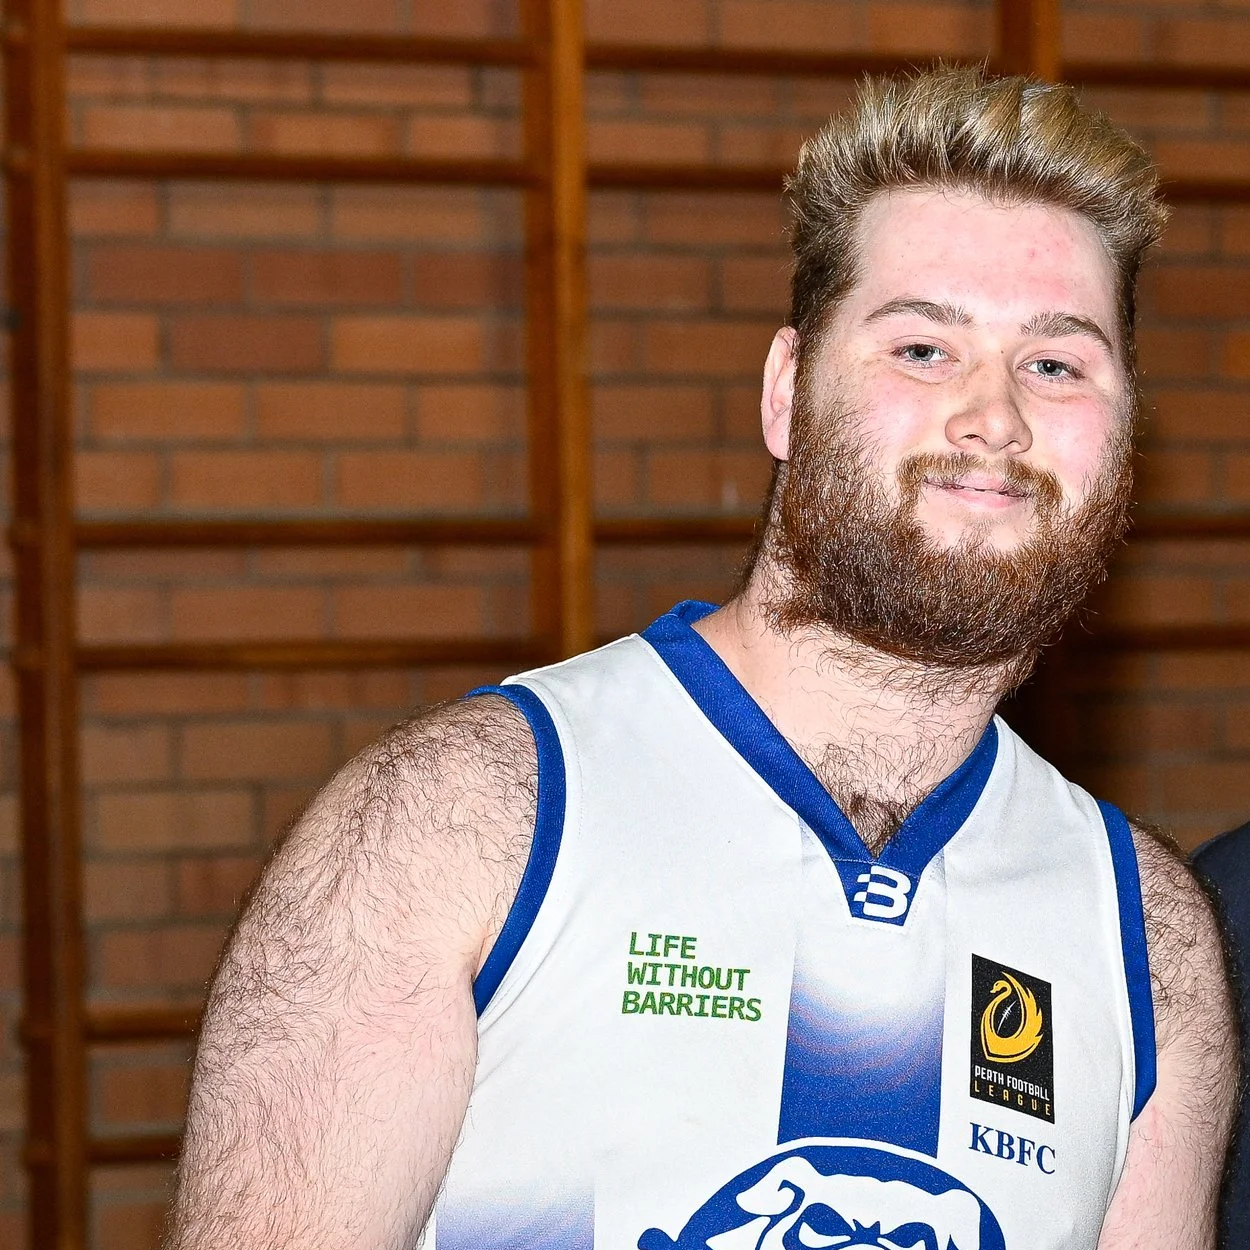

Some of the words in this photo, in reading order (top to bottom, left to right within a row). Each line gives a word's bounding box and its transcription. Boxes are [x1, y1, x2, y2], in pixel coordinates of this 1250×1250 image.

[629, 931, 698, 960] LIFE
[627, 961, 751, 991] WITHOUT
[621, 990, 762, 1022] BARRIERS
[974, 1064, 1004, 1086] PERTH
[1007, 1075, 1050, 1102] FOOTBALL
[974, 1080, 1051, 1116] LEAGUE
[968, 1121, 1056, 1175] KBFC
